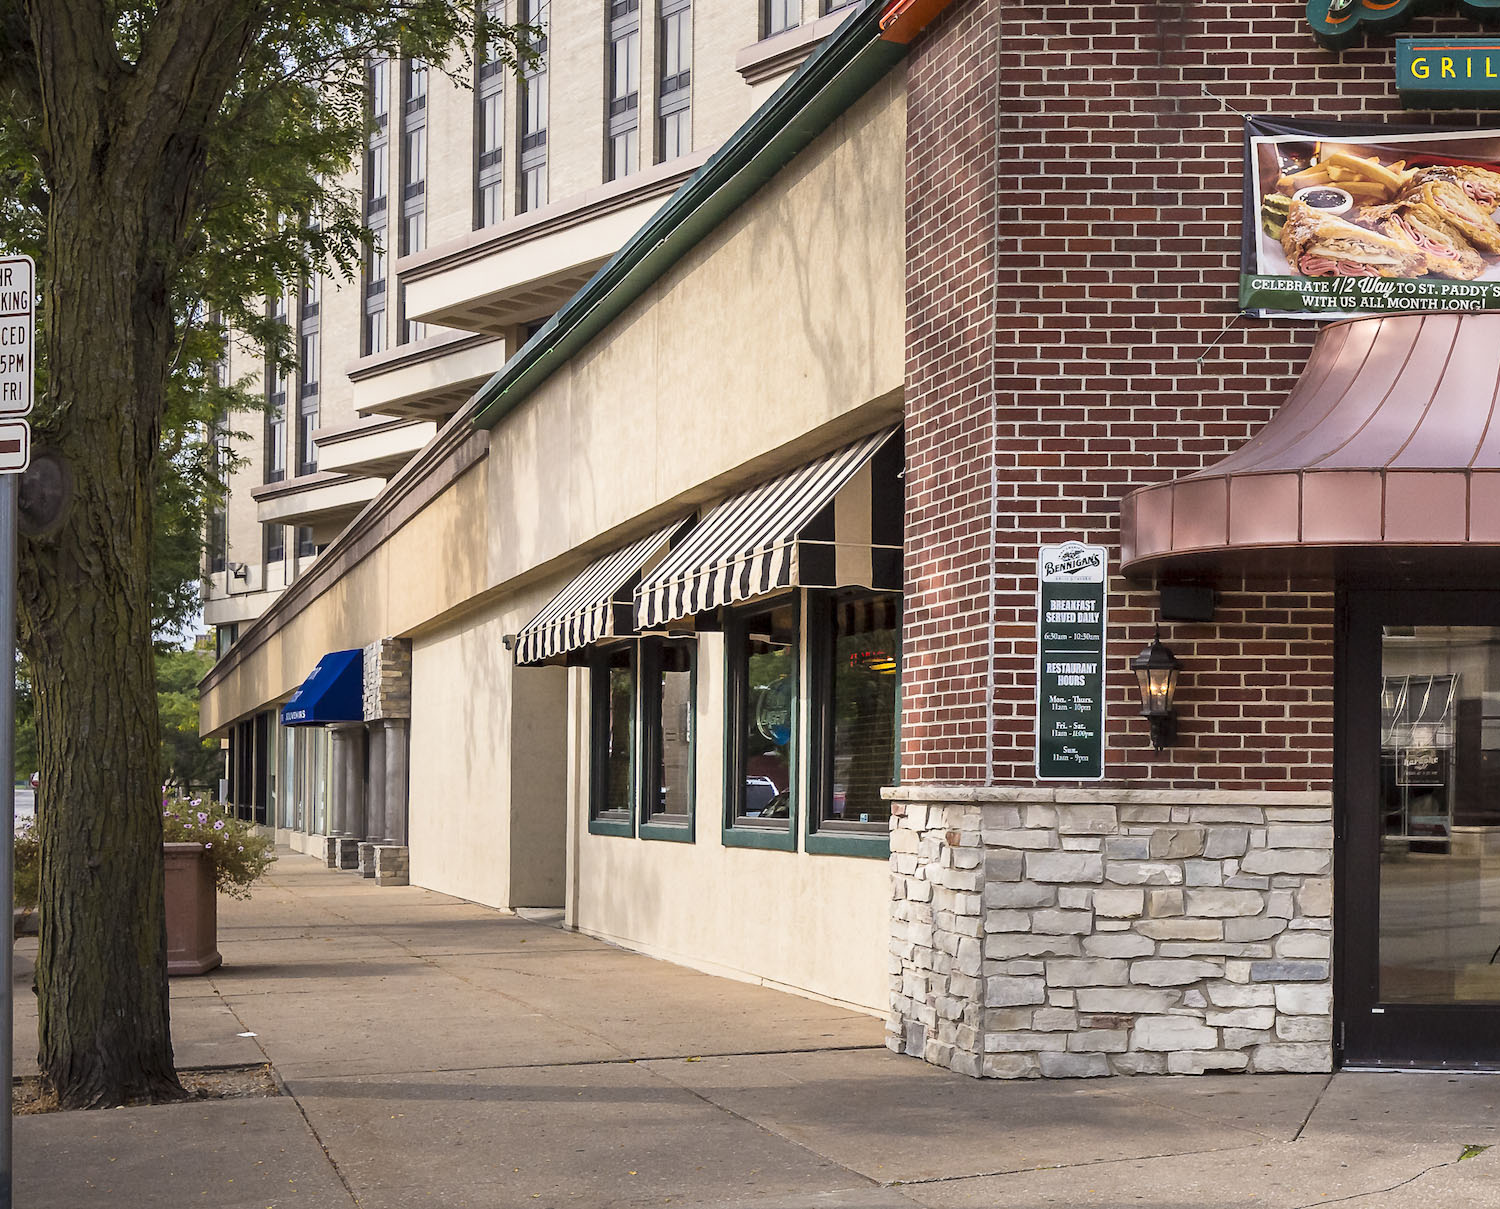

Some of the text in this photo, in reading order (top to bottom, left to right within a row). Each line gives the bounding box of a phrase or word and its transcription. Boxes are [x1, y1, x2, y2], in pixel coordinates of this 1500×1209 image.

[1251, 278, 1330, 293] CELEBRATE
[1331, 276, 1355, 293] 1/2
[1357, 276, 1396, 299] Way
[1396, 282, 1416, 294] TO
[1418, 282, 1439, 295] ST.
[1441, 283, 1500, 299] PADDY'S
[1301, 295, 1486, 311] WITH US ALL MONTH LONG!
[1044, 553, 1100, 577] BENNIGAN'S
[1050, 600, 1096, 611] BREAKFAST
[1046, 612, 1100, 623] SERVED DAILY
[1046, 663, 1097, 674] RESTAURANT
[1057, 675, 1086, 686] HOURS
[1049, 695, 1067, 703] Mon.
[1072, 695, 1093, 703] Thurs.
[1052, 703, 1068, 711] 11am
[1056, 721, 1068, 729] Fri.
[1072, 721, 1086, 730] Sat.
[1051, 729, 1068, 737] 11am
[1063, 745, 1078, 754] Sun.
